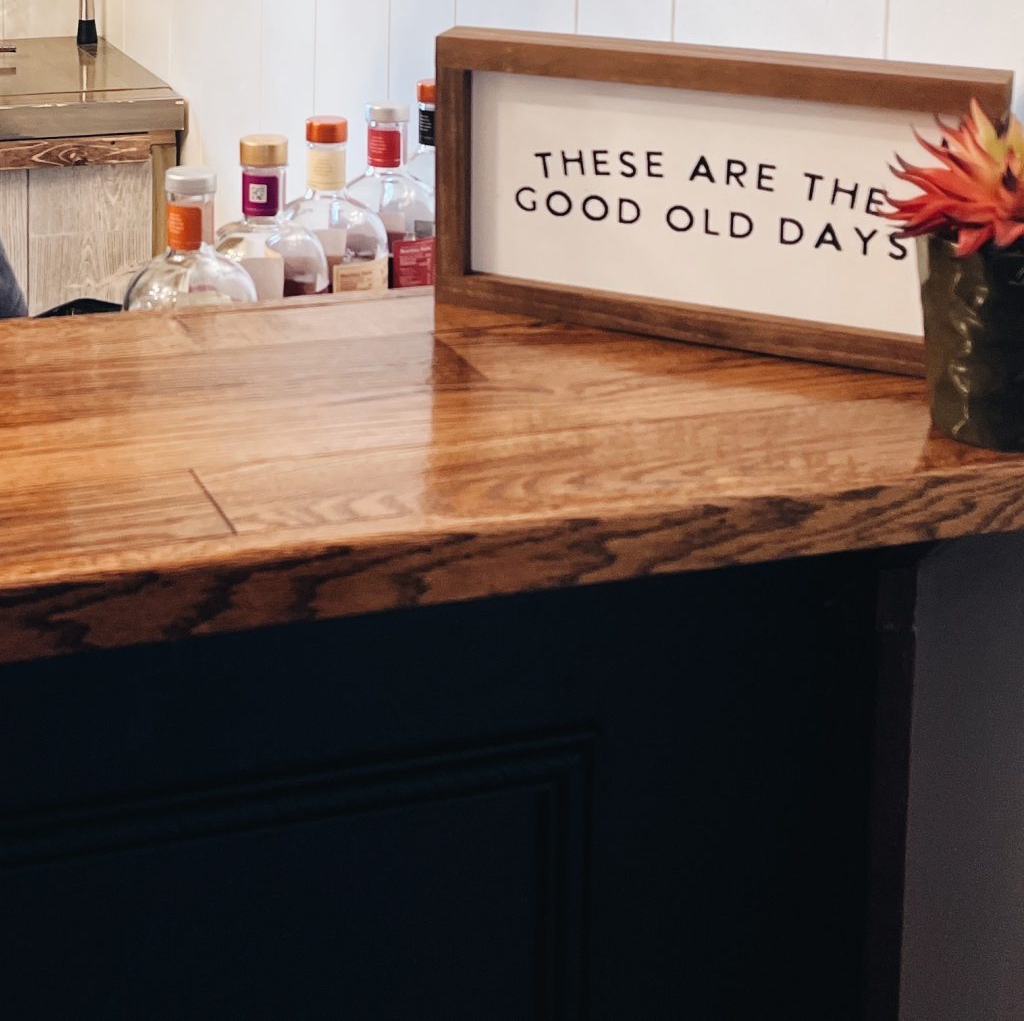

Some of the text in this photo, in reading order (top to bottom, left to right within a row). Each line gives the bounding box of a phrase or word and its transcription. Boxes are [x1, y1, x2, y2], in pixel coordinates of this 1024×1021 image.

[533, 149, 888, 217] THESE ARE THE
[515, 186, 908, 261] GOOD OLD DAYS
